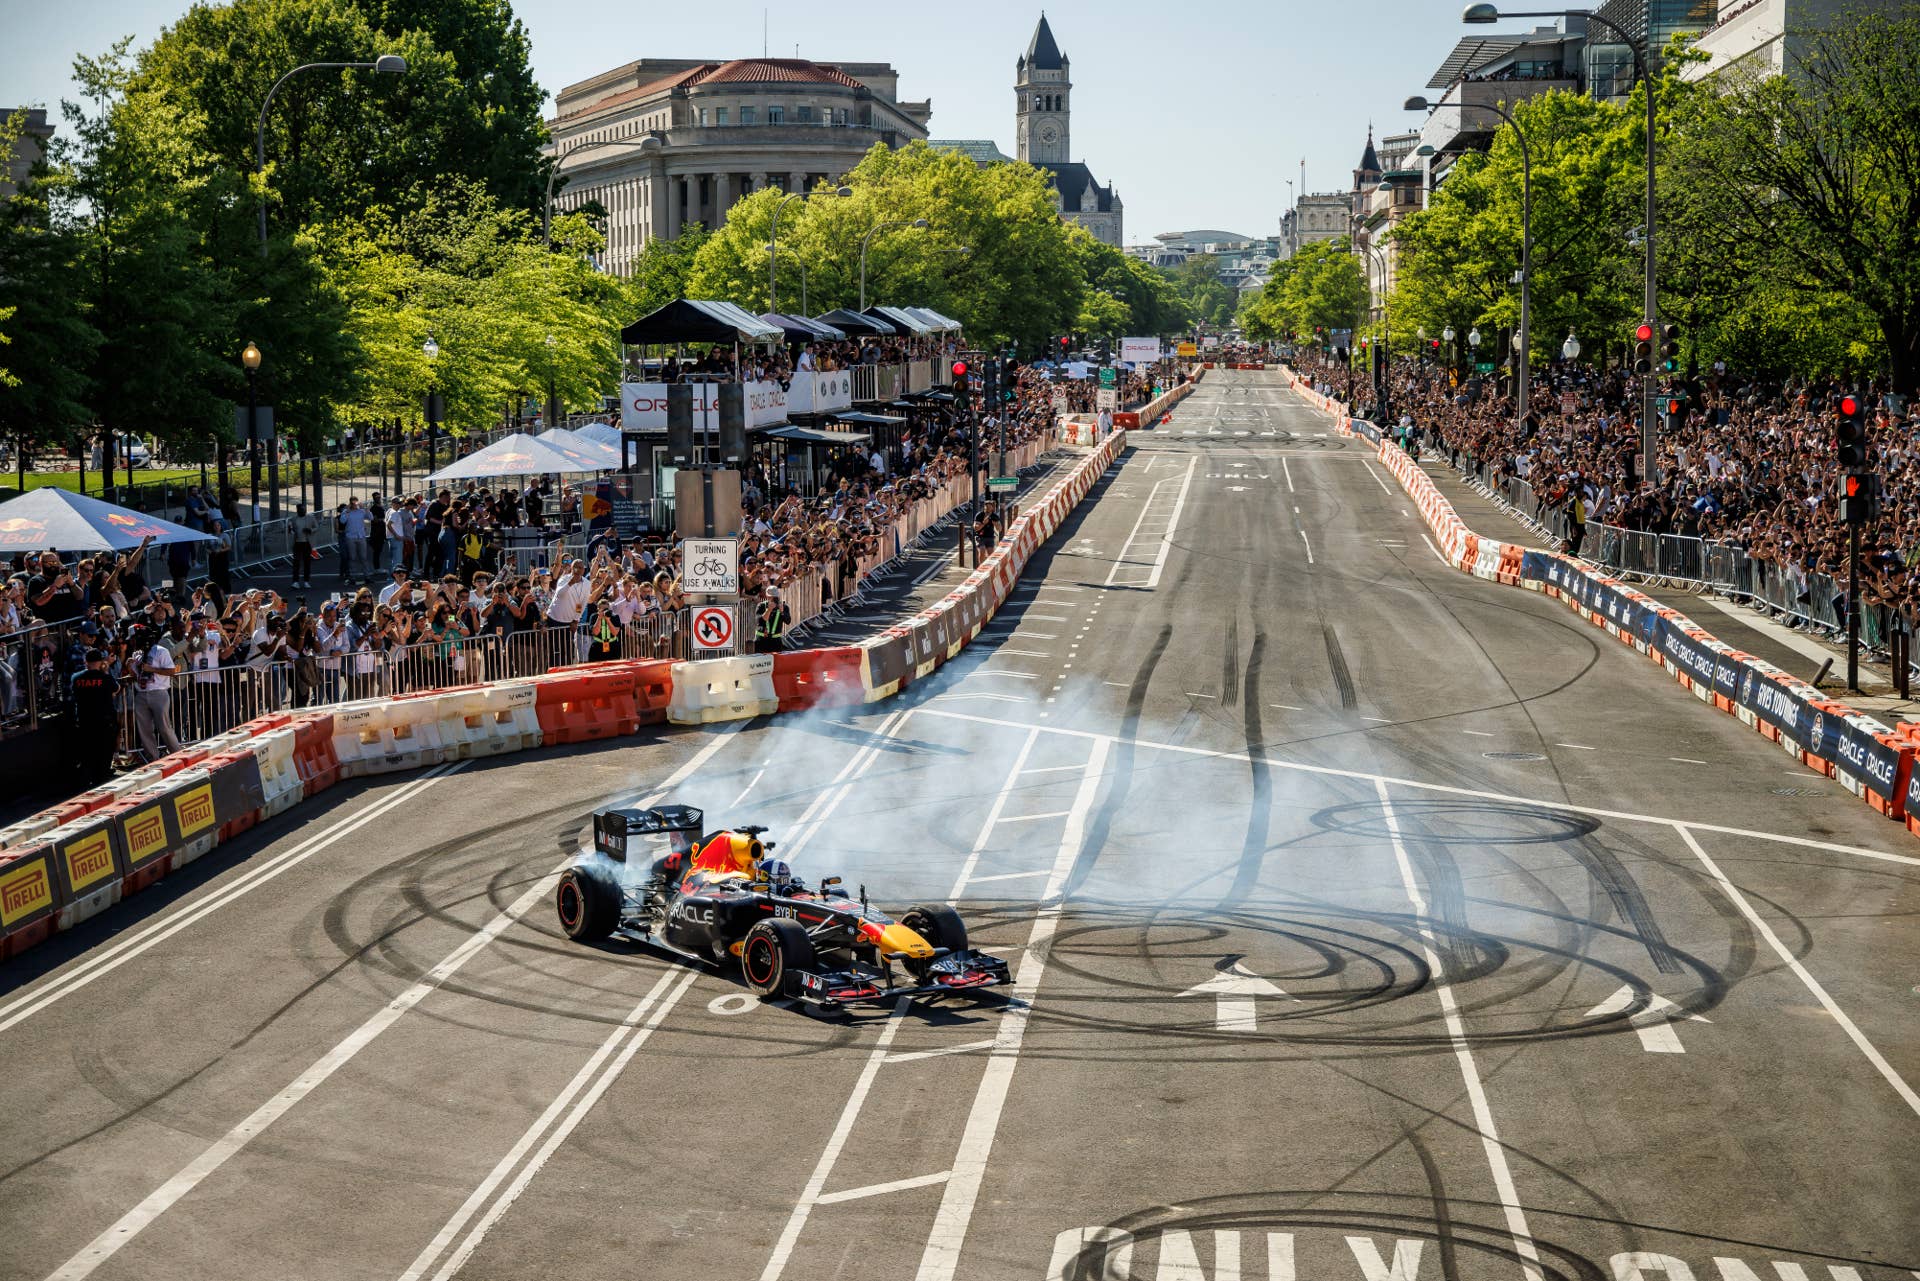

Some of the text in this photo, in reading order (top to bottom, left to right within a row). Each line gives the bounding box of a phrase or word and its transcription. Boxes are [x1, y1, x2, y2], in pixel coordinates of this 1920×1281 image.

[634, 399, 719, 411] ORLE
[695, 545, 727, 554] TURNING
[685, 578, 736, 588] USE X-WALKS
[1678, 645, 1695, 666] ORACLE
[1695, 655, 1714, 678] ORACLE
[1717, 665, 1736, 687] ORACLE
[1757, 683, 1774, 709] GIVES
[1771, 690, 1786, 717] YOU
[1838, 735, 1893, 784] ORACLE ORACLE
[179, 793, 211, 829] PIRELLI
[128, 815, 162, 852] PIRELLI
[70, 840, 109, 881] PIRELLI
[1, 869, 46, 914] PIRELLI
[774, 905, 798, 920] BYBIT
